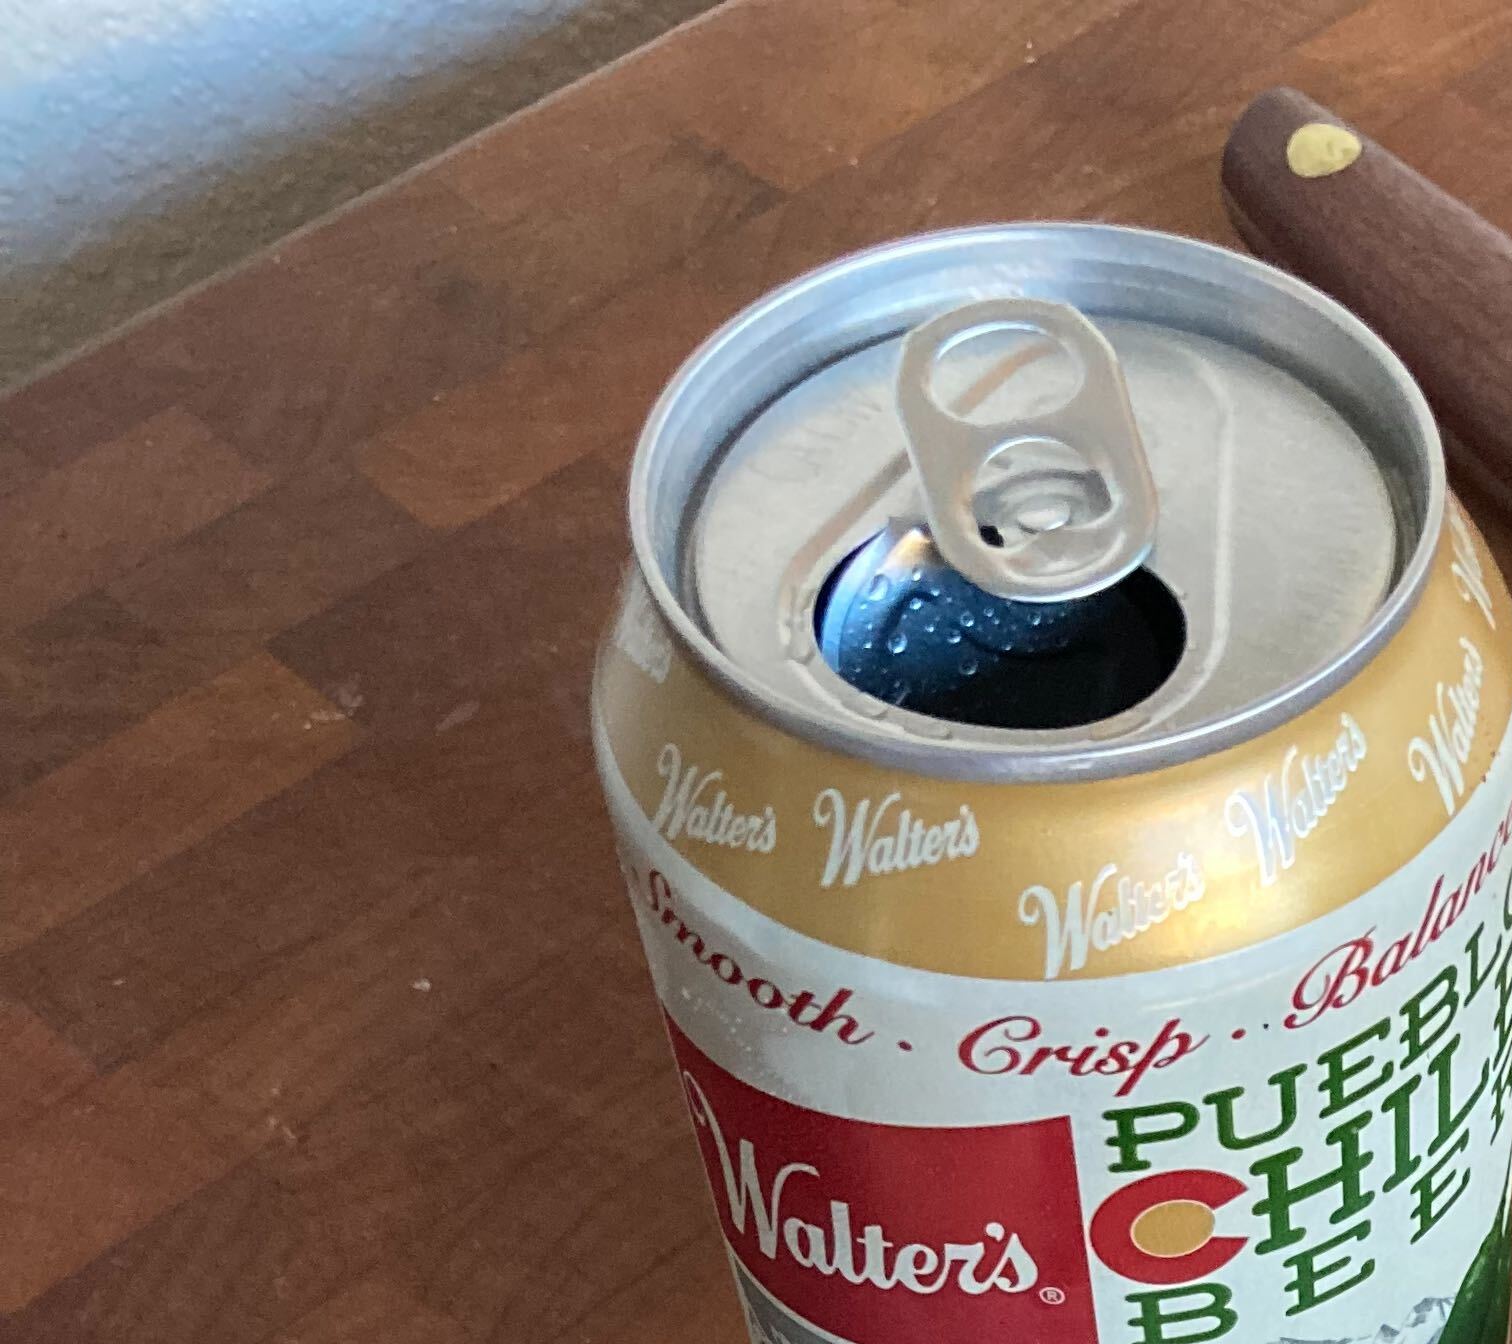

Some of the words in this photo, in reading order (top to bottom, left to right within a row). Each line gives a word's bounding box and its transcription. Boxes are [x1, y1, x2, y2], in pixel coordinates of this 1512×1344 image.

[656, 743, 776, 854] Walter's
[813, 788, 981, 888] Walter's
[1018, 850, 1207, 980] Walter's
[1225, 712, 1367, 887] Walter's
[647, 868, 875, 1047] Smooth
[957, 1014, 1211, 1097] Crisp
[681, 1068, 1040, 1295] Walter's
